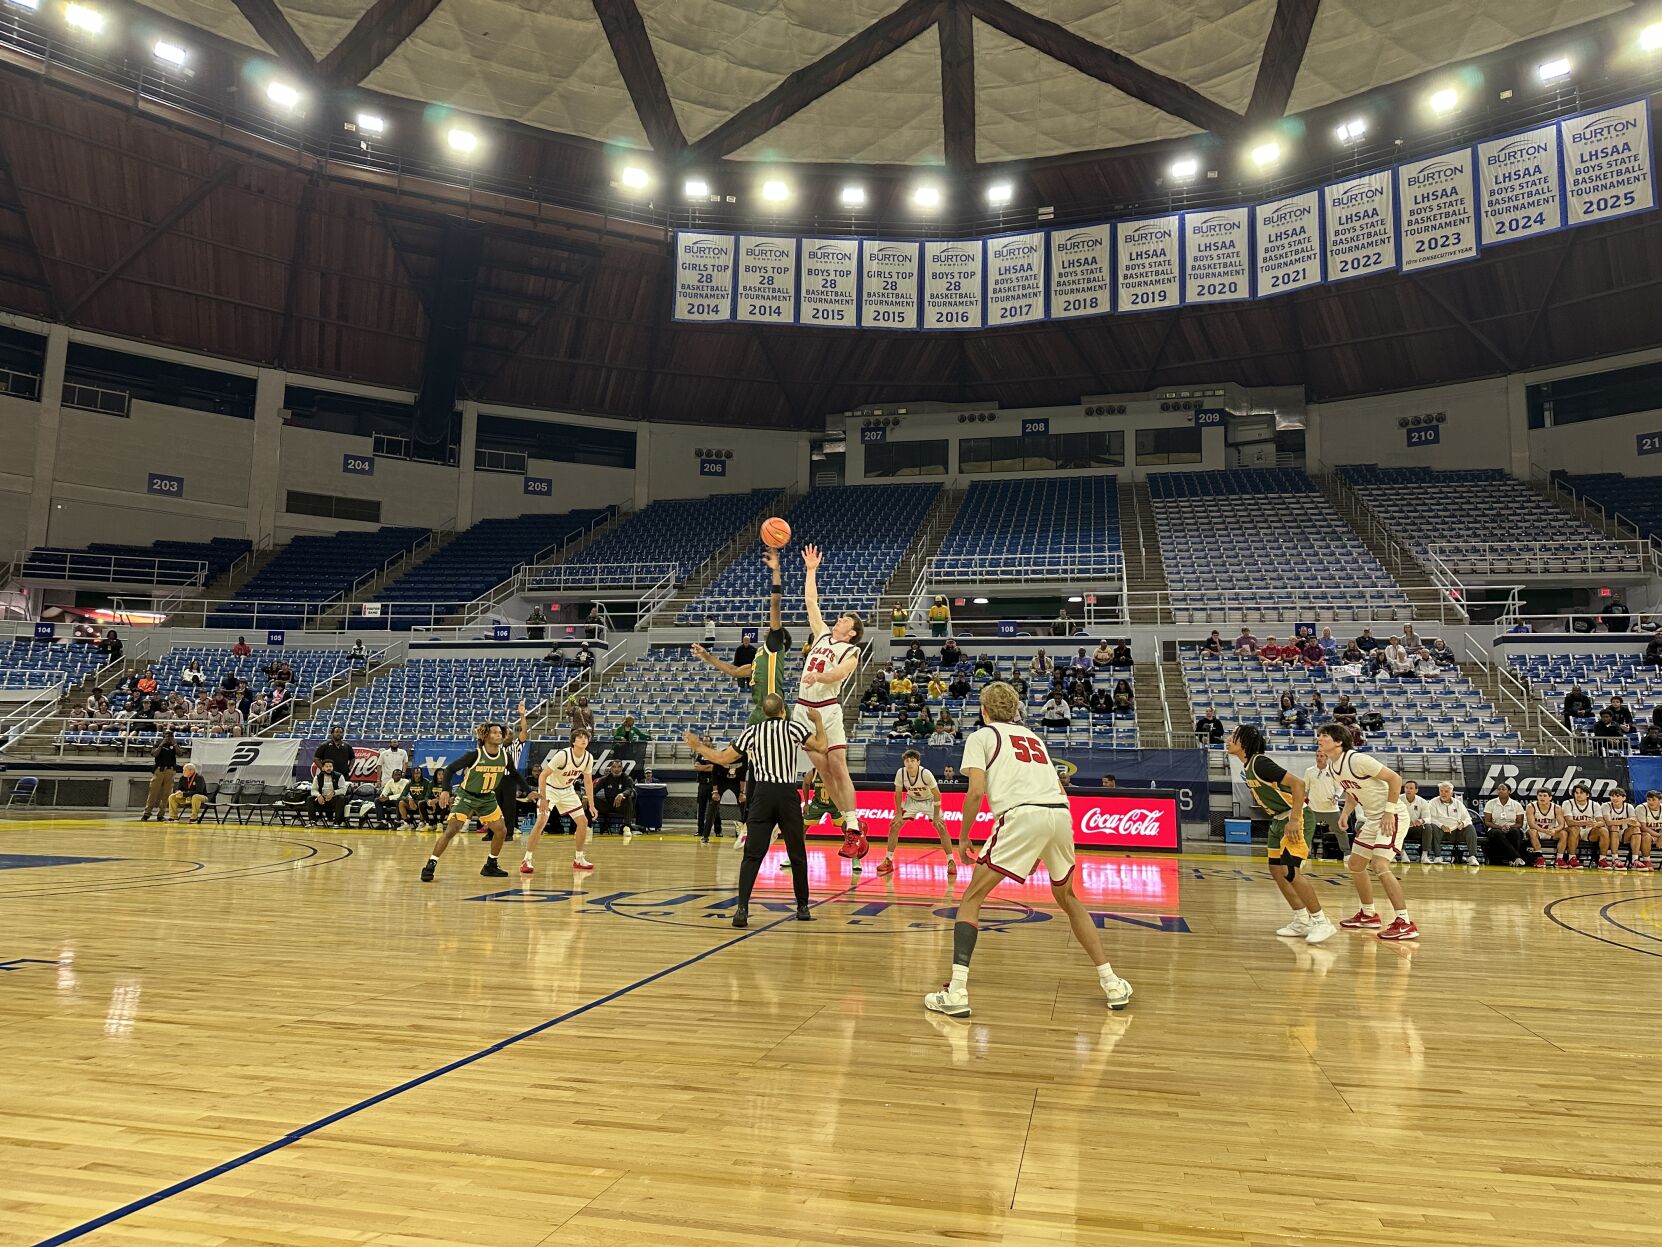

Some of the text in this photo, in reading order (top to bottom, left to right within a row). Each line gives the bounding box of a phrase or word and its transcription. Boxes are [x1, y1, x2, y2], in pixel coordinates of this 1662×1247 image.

[1573, 118, 1637, 144] BURTON
[1488, 143, 1548, 166] BURTON
[1580, 142, 1631, 164] LHSAA
[1575, 154, 1640, 176] BOYS STATE
[1408, 165, 1463, 186] BURTON
[1495, 165, 1542, 185] LHSAA
[1573, 164, 1644, 187] BASKETBALL
[1490, 176, 1549, 196] BOYS STATE
[1569, 173, 1648, 197] TOURNAMENT
[1333, 186, 1384, 207] BURTON
[1414, 186, 1458, 205] LHSAA
[1488, 186, 1552, 207] BASKETBALL
[1410, 198, 1465, 216] BOYS STATE
[1484, 195, 1557, 218] TOURNAMENT
[1584, 191, 1636, 214] 2025
[1264, 206, 1310, 225] BURTON
[1338, 208, 1379, 225] LHSAA
[1408, 207, 1468, 226] BASKETBALL
[1193, 221, 1240, 234] BURTON
[1335, 218, 1386, 236] BOYS STATE
[1404, 216, 1471, 236] TOURNAMENT
[1496, 212, 1545, 235] 2024
[1125, 230, 1171, 243] BURTON
[1269, 226, 1306, 243] LHSAA
[1333, 228, 1388, 246] BASKETBALL
[1058, 238, 1102, 251] BURTON
[1198, 240, 1235, 252] LHSAA
[1265, 236, 1312, 254] BOYS STATE
[1330, 236, 1391, 256] TOURNAMENT
[1416, 232, 1462, 253] 2023
[685, 245, 727, 255] BURTON
[746, 248, 789, 258] BURTON
[809, 251, 851, 260] BURTON
[994, 245, 1037, 258] BURTON
[1130, 248, 1166, 261] LHSAA
[1217, 251, 1240, 260] STATE
[1263, 245, 1315, 263] BASKETBALL
[1419, 250, 1457, 262] CONSECUTIVE
[870, 253, 912, 262] BURTON
[933, 254, 974, 263] BURTON
[1062, 256, 1097, 269] LHSAA
[1260, 253, 1317, 273] TOURNAMENT
[1340, 252, 1382, 272] 2022
[682, 263, 708, 271] GIRLS
[745, 265, 768, 273] BOYS
[808, 268, 830, 276] BOYS
[999, 263, 1033, 276] LHSAA
[1126, 260, 1172, 271] BOYS STATE
[1192, 260, 1242, 271] BASKETBALL
[698, 274, 712, 283] 28
[1016, 274, 1037, 282] STATE
[1059, 267, 1103, 278] BOYS STATE
[1124, 268, 1174, 280] BASKETBALL
[1189, 269, 1245, 280] TOURNAMENT
[1272, 268, 1306, 287] 2021
[759, 276, 774, 285] 28
[822, 279, 836, 288] 28
[883, 281, 897, 290] 28
[946, 281, 961, 291] 28
[1057, 276, 1105, 287] BASKETBALL
[1121, 276, 1177, 288] TOURNAMENT
[678, 291, 729, 299] TOURNAMENT
[806, 289, 852, 297] BASKETBALL
[993, 283, 1039, 294] BASKETBALL
[1054, 284, 1107, 296] TOURNAMENT
[1197, 282, 1237, 296] 2020
[739, 293, 792, 301] TOURNAMENT
[803, 296, 854, 305] TOURNAMENT
[990, 291, 1042, 303] TOURNAMENT
[1131, 290, 1166, 304] 2019
[688, 303, 719, 314] 2014
[749, 305, 782, 316] 2014
[1064, 297, 1098, 311] 2018
[812, 308, 844, 320] 2015
[873, 311, 905, 322] 2015
[936, 312, 968, 322] 2016
[1000, 304, 1032, 318] 2017
[1199, 413, 1219, 422] 209
[1026, 423, 1044, 432] 208
[865, 432, 882, 440] 207
[1412, 430, 1434, 442] 210
[348, 460, 369, 470] 204
[704, 464, 722, 472] 206
[153, 479, 178, 491] 203
[528, 482, 547, 491] 205
[807, 656, 826, 674] 54
[1008, 735, 1048, 765] 55
[482, 772, 498, 790] 11
[855, 809, 896, 819] FICIAL
[1081, 808, 1164, 836] Coca-Cola
[464, 888, 1192, 933] BURTON
